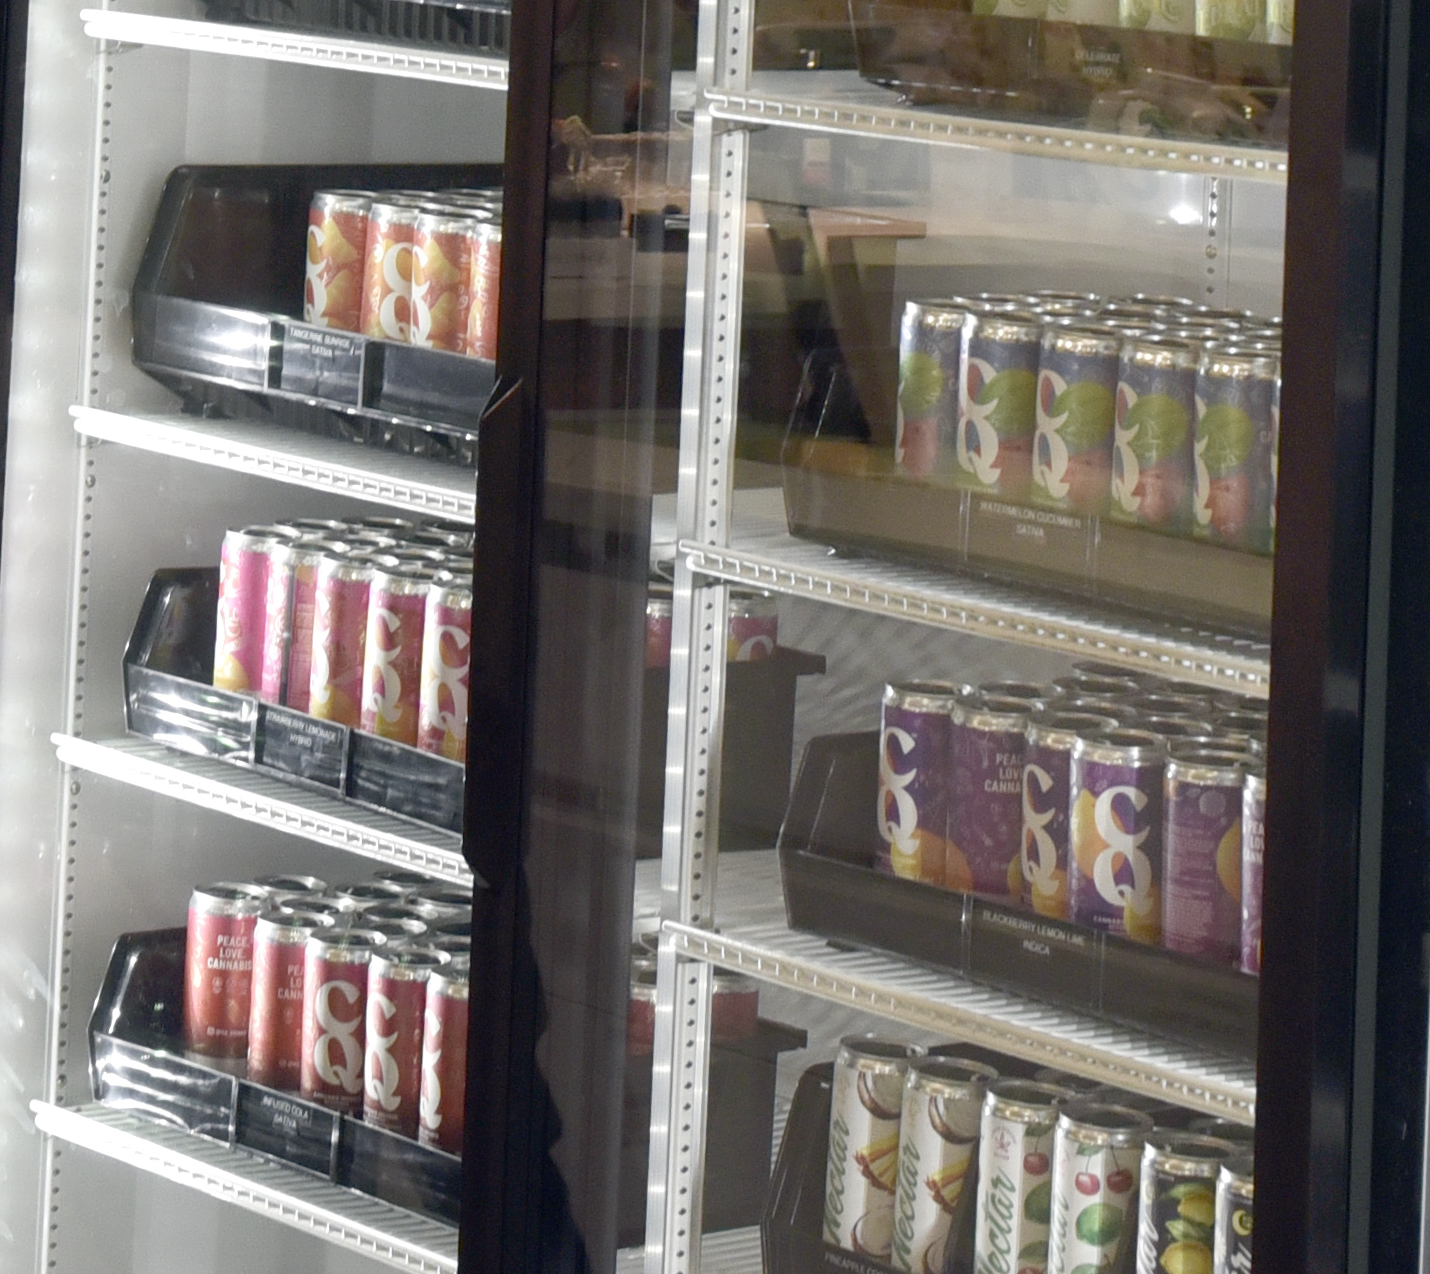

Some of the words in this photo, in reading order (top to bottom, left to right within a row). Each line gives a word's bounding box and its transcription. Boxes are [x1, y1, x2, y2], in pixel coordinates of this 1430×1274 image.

[980, 501, 1036, 521] WATERMELON
[1036, 511, 1081, 529] CUCUMBER
[1016, 524, 1044, 537] SATIVA
[983, 910, 1036, 933] BLACKBERRY
[1037, 923, 1067, 941] LEMON
[1067, 931, 1086, 946] LIME
[217, 935, 250, 948] PEACE.
[1023, 939, 1050, 956] INDICA
[219, 949, 244, 959] LOVE.
[207, 960, 252, 971] CANNABIS
